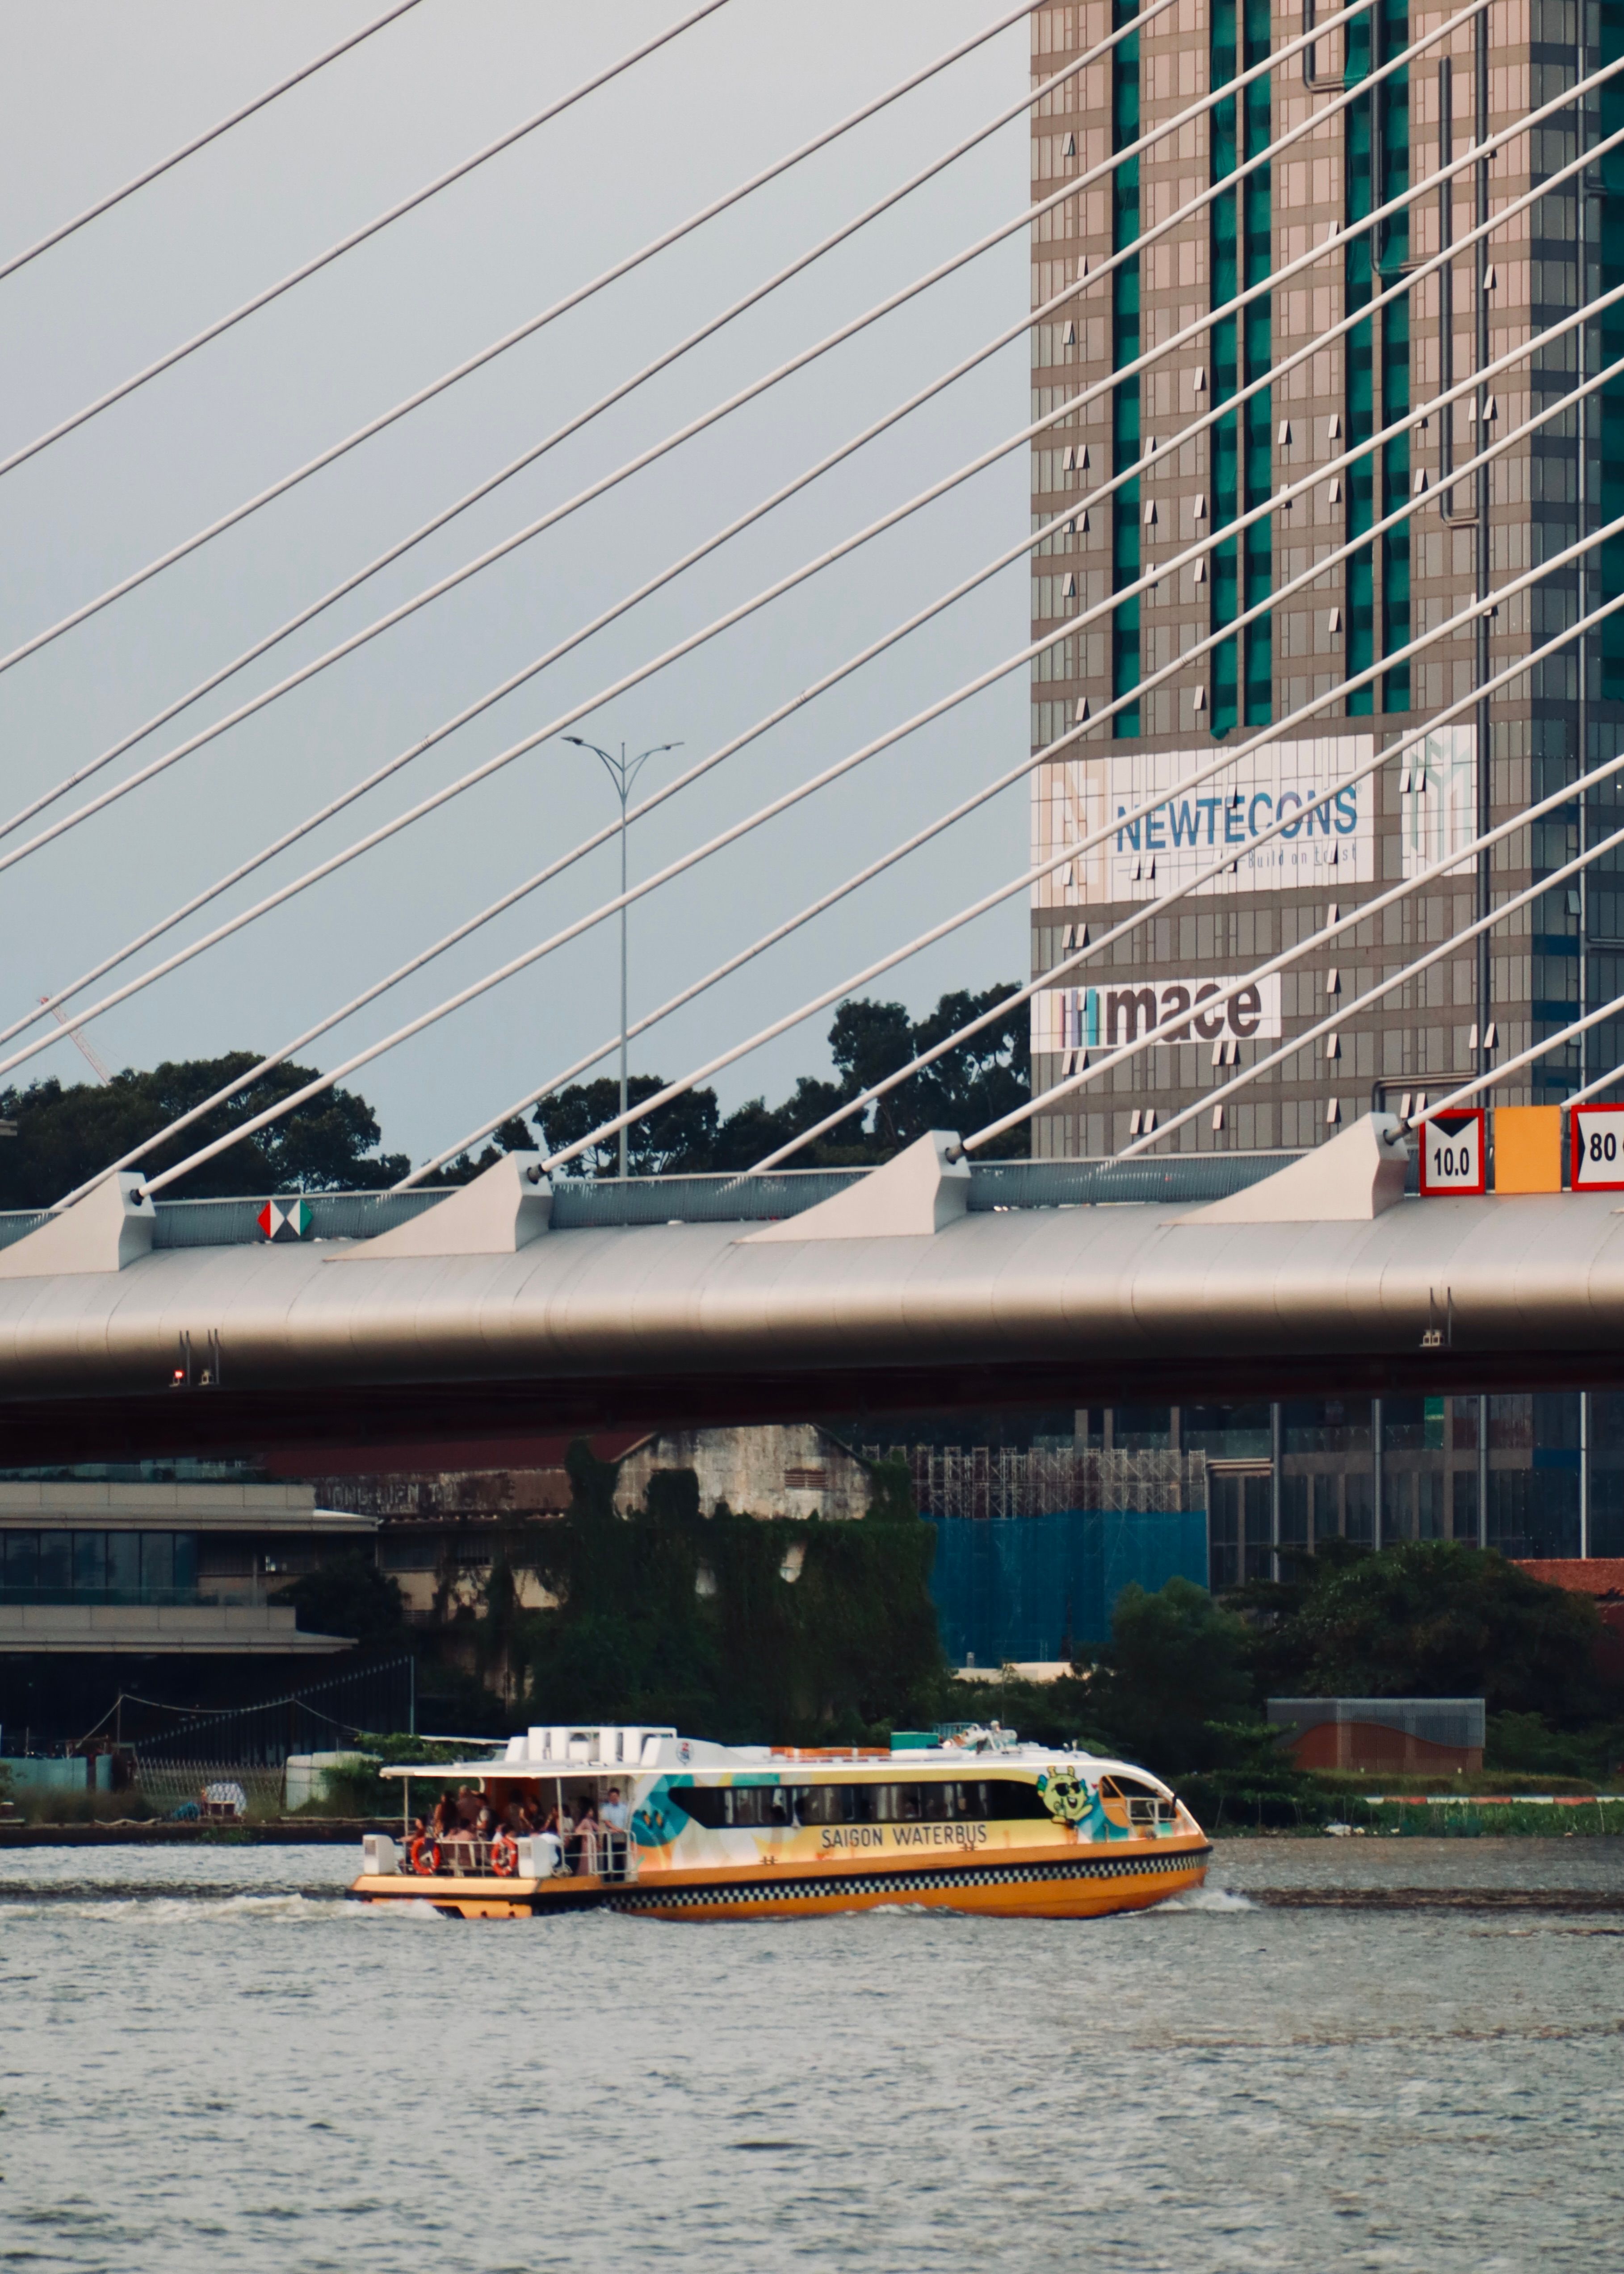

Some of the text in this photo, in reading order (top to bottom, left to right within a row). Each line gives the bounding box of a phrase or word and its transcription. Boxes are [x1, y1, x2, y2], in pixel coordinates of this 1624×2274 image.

[1117, 785, 1357, 852] NEWTECONS
[1248, 849, 1284, 869] Build
[1292, 852, 1307, 865] on
[1107, 983, 1262, 1046] mace
[1434, 1147, 1469, 1177] 10.0
[1590, 1133, 1616, 1162] 80
[822, 1824, 987, 1849] SAIGON WATERBUS
